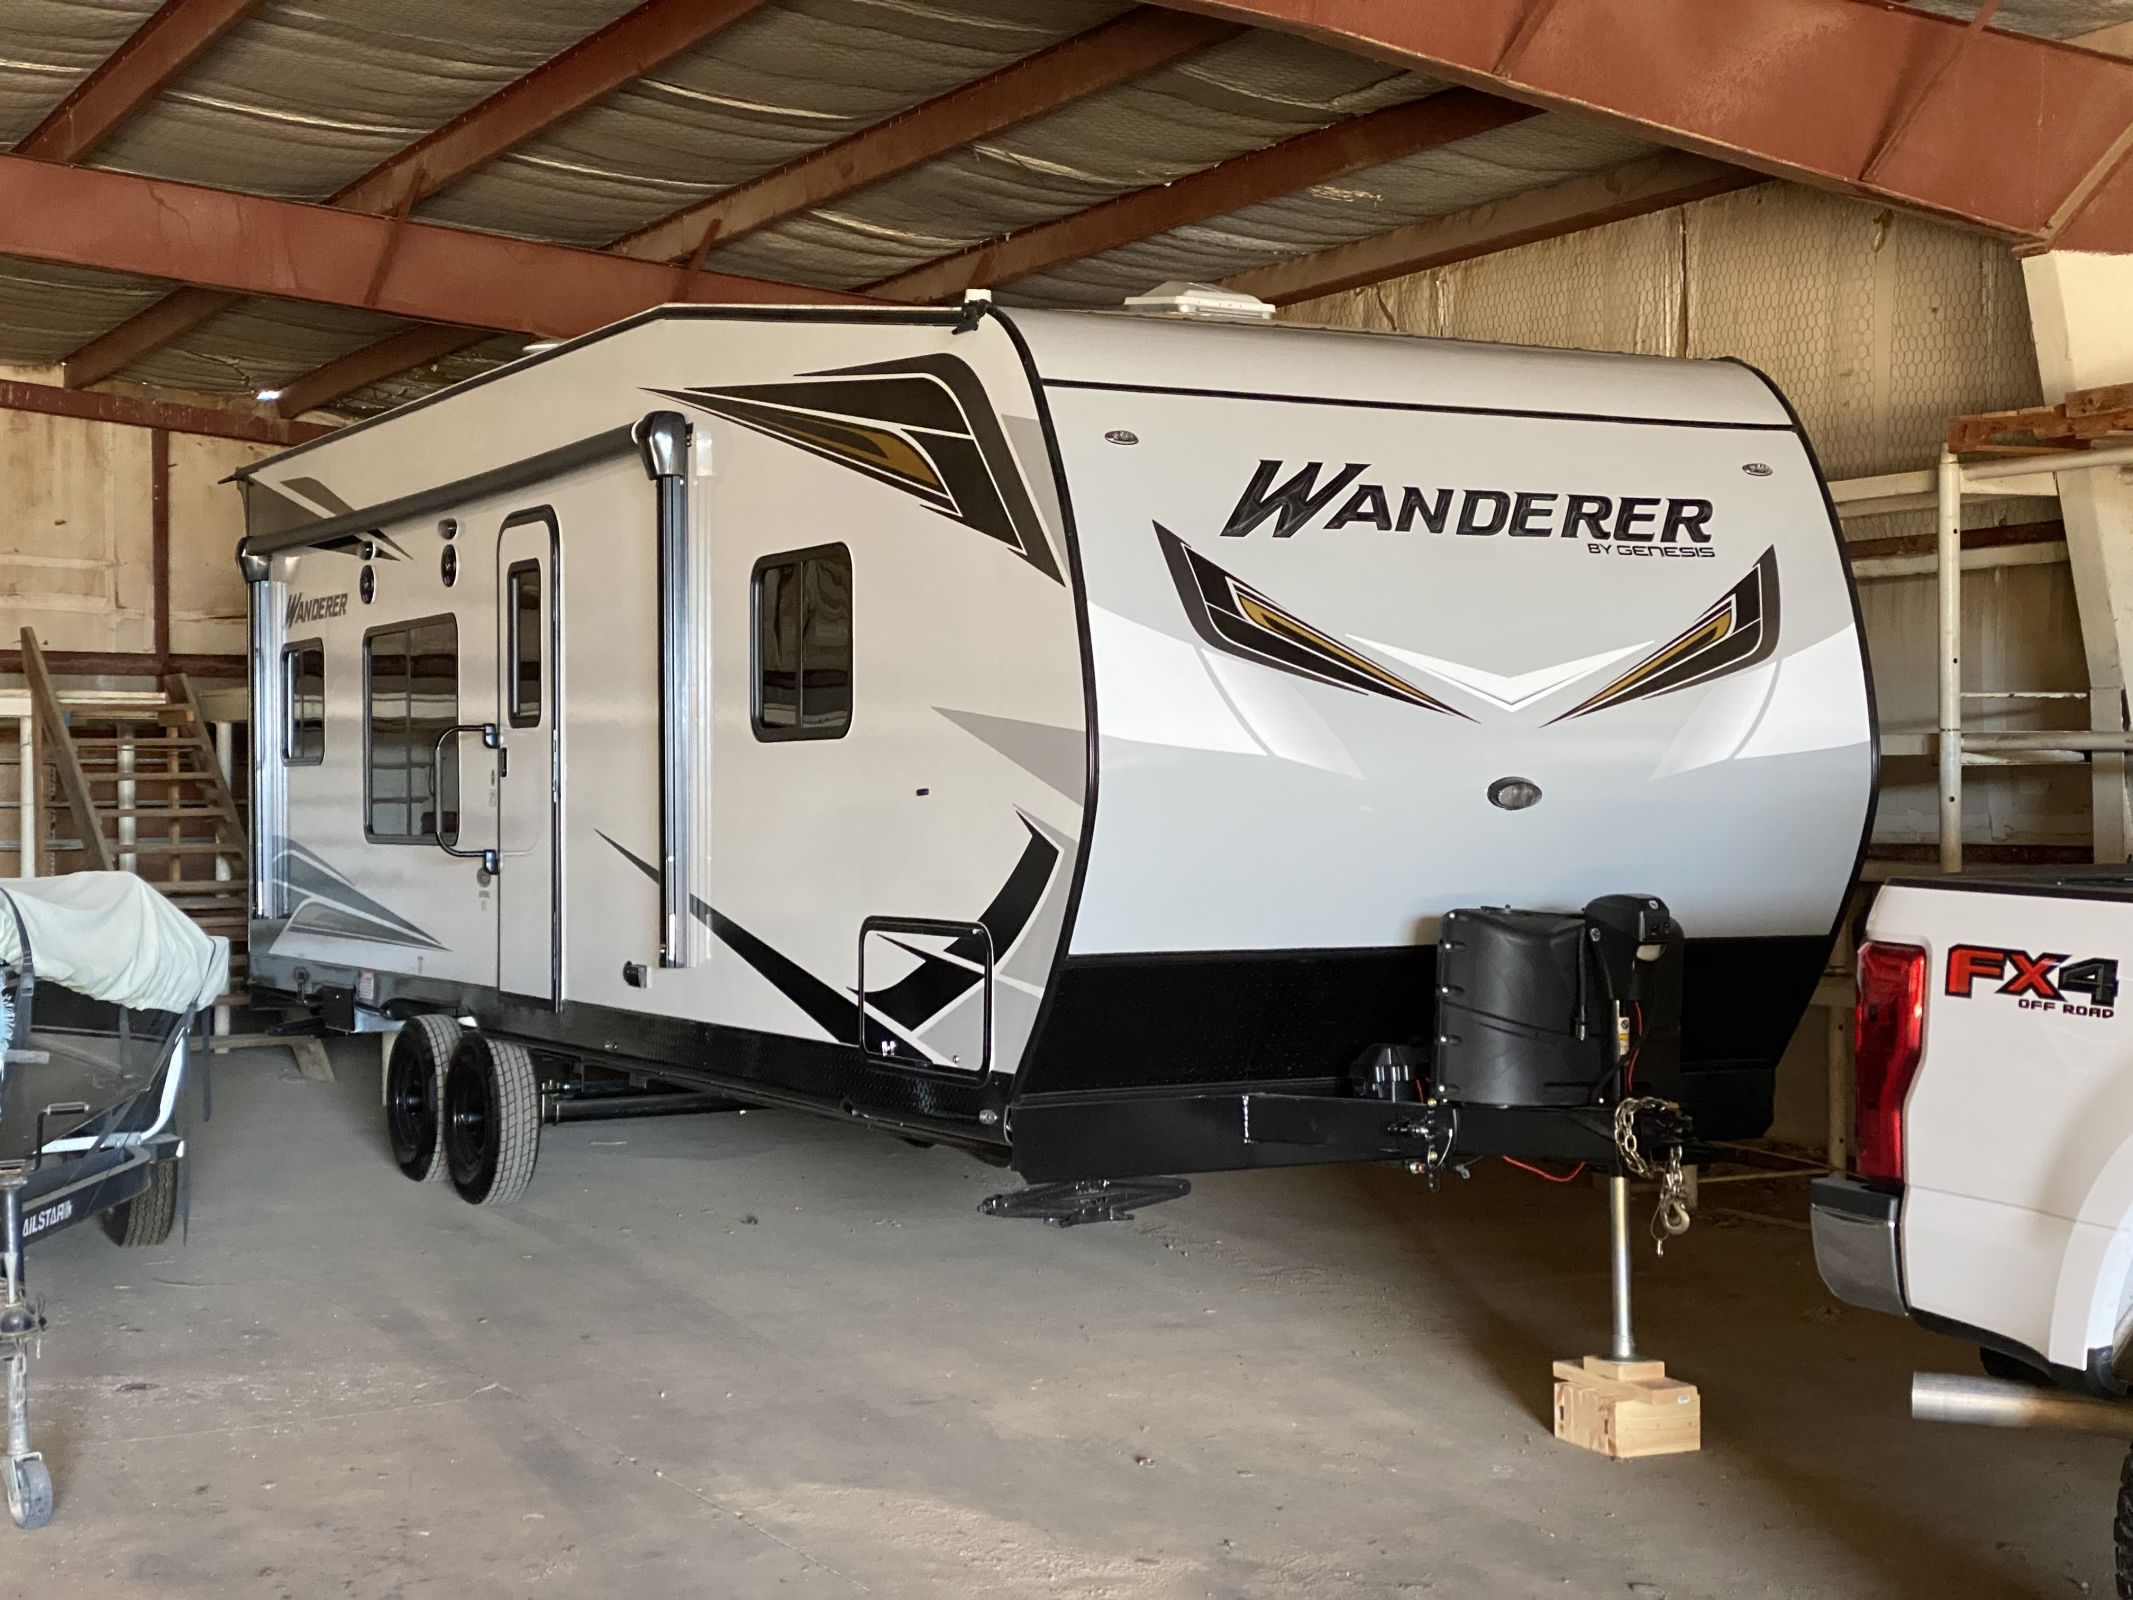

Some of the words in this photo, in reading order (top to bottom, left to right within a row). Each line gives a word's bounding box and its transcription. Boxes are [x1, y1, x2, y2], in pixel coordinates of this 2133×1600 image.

[1219, 459, 1713, 543] WANDERER
[1587, 543, 1612, 555] BY
[1616, 545, 1716, 558] GENESIS
[285, 592, 348, 629] WANDERER
[1944, 943, 2119, 1008] FX4
[2018, 999, 2056, 1011] OFF
[2062, 1003, 2115, 1019] ROAD
[22, 1202, 65, 1237] AILSTAR
